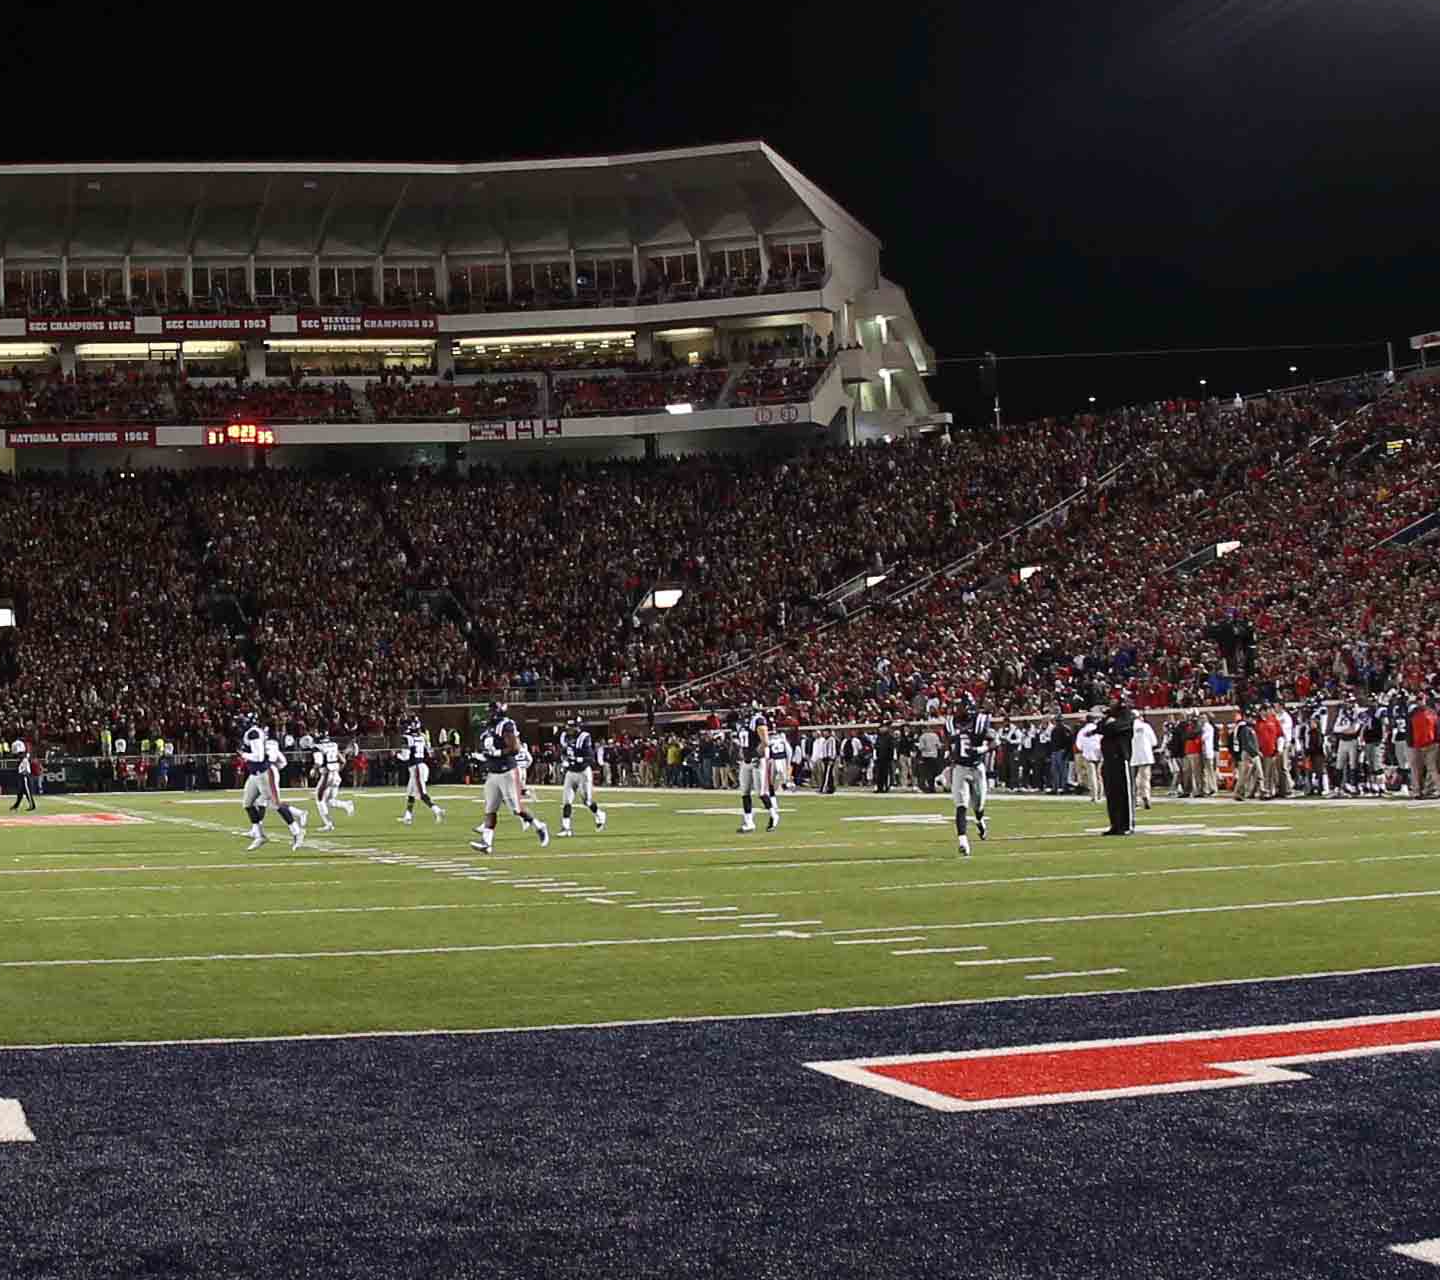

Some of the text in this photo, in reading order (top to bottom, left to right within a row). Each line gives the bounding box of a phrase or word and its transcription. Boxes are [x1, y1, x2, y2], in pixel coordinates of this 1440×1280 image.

[29, 322, 47, 332] SEC
[50, 321, 104, 331] CHAMPIONS
[166, 320, 184, 330] SEC
[186, 319, 240, 329] CHAMPIONS
[301, 319, 320, 329] SEC
[364, 319, 420, 329] CHAMPIONS
[10, 433, 59, 443] NATIONAL
[61, 431, 118, 442] CHAMPIONS
